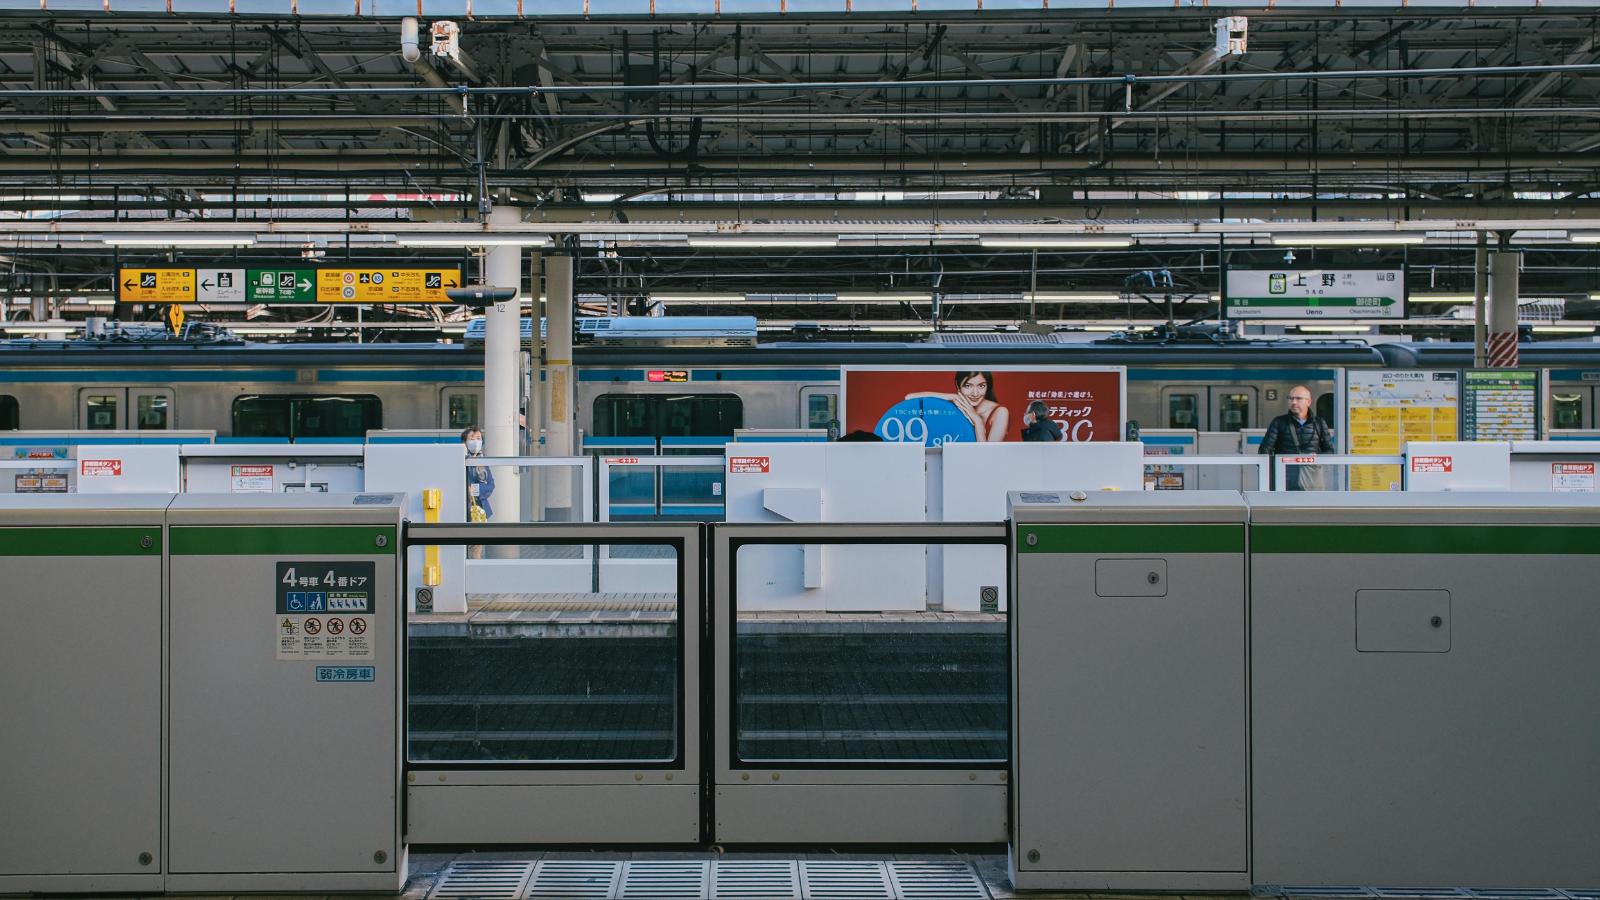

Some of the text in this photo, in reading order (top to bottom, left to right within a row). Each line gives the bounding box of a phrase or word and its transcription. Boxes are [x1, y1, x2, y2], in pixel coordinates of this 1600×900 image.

[1293, 273, 1335, 287] 上野
[1356, 298, 1381, 306] 御徒町
[496, 304, 506, 313] 12
[1049, 406, 1092, 417] テティック
[1053, 419, 1094, 442] BC
[282, 567, 367, 587] 4号車 4番ドア
[320, 669, 371, 680] 弱冷房車
